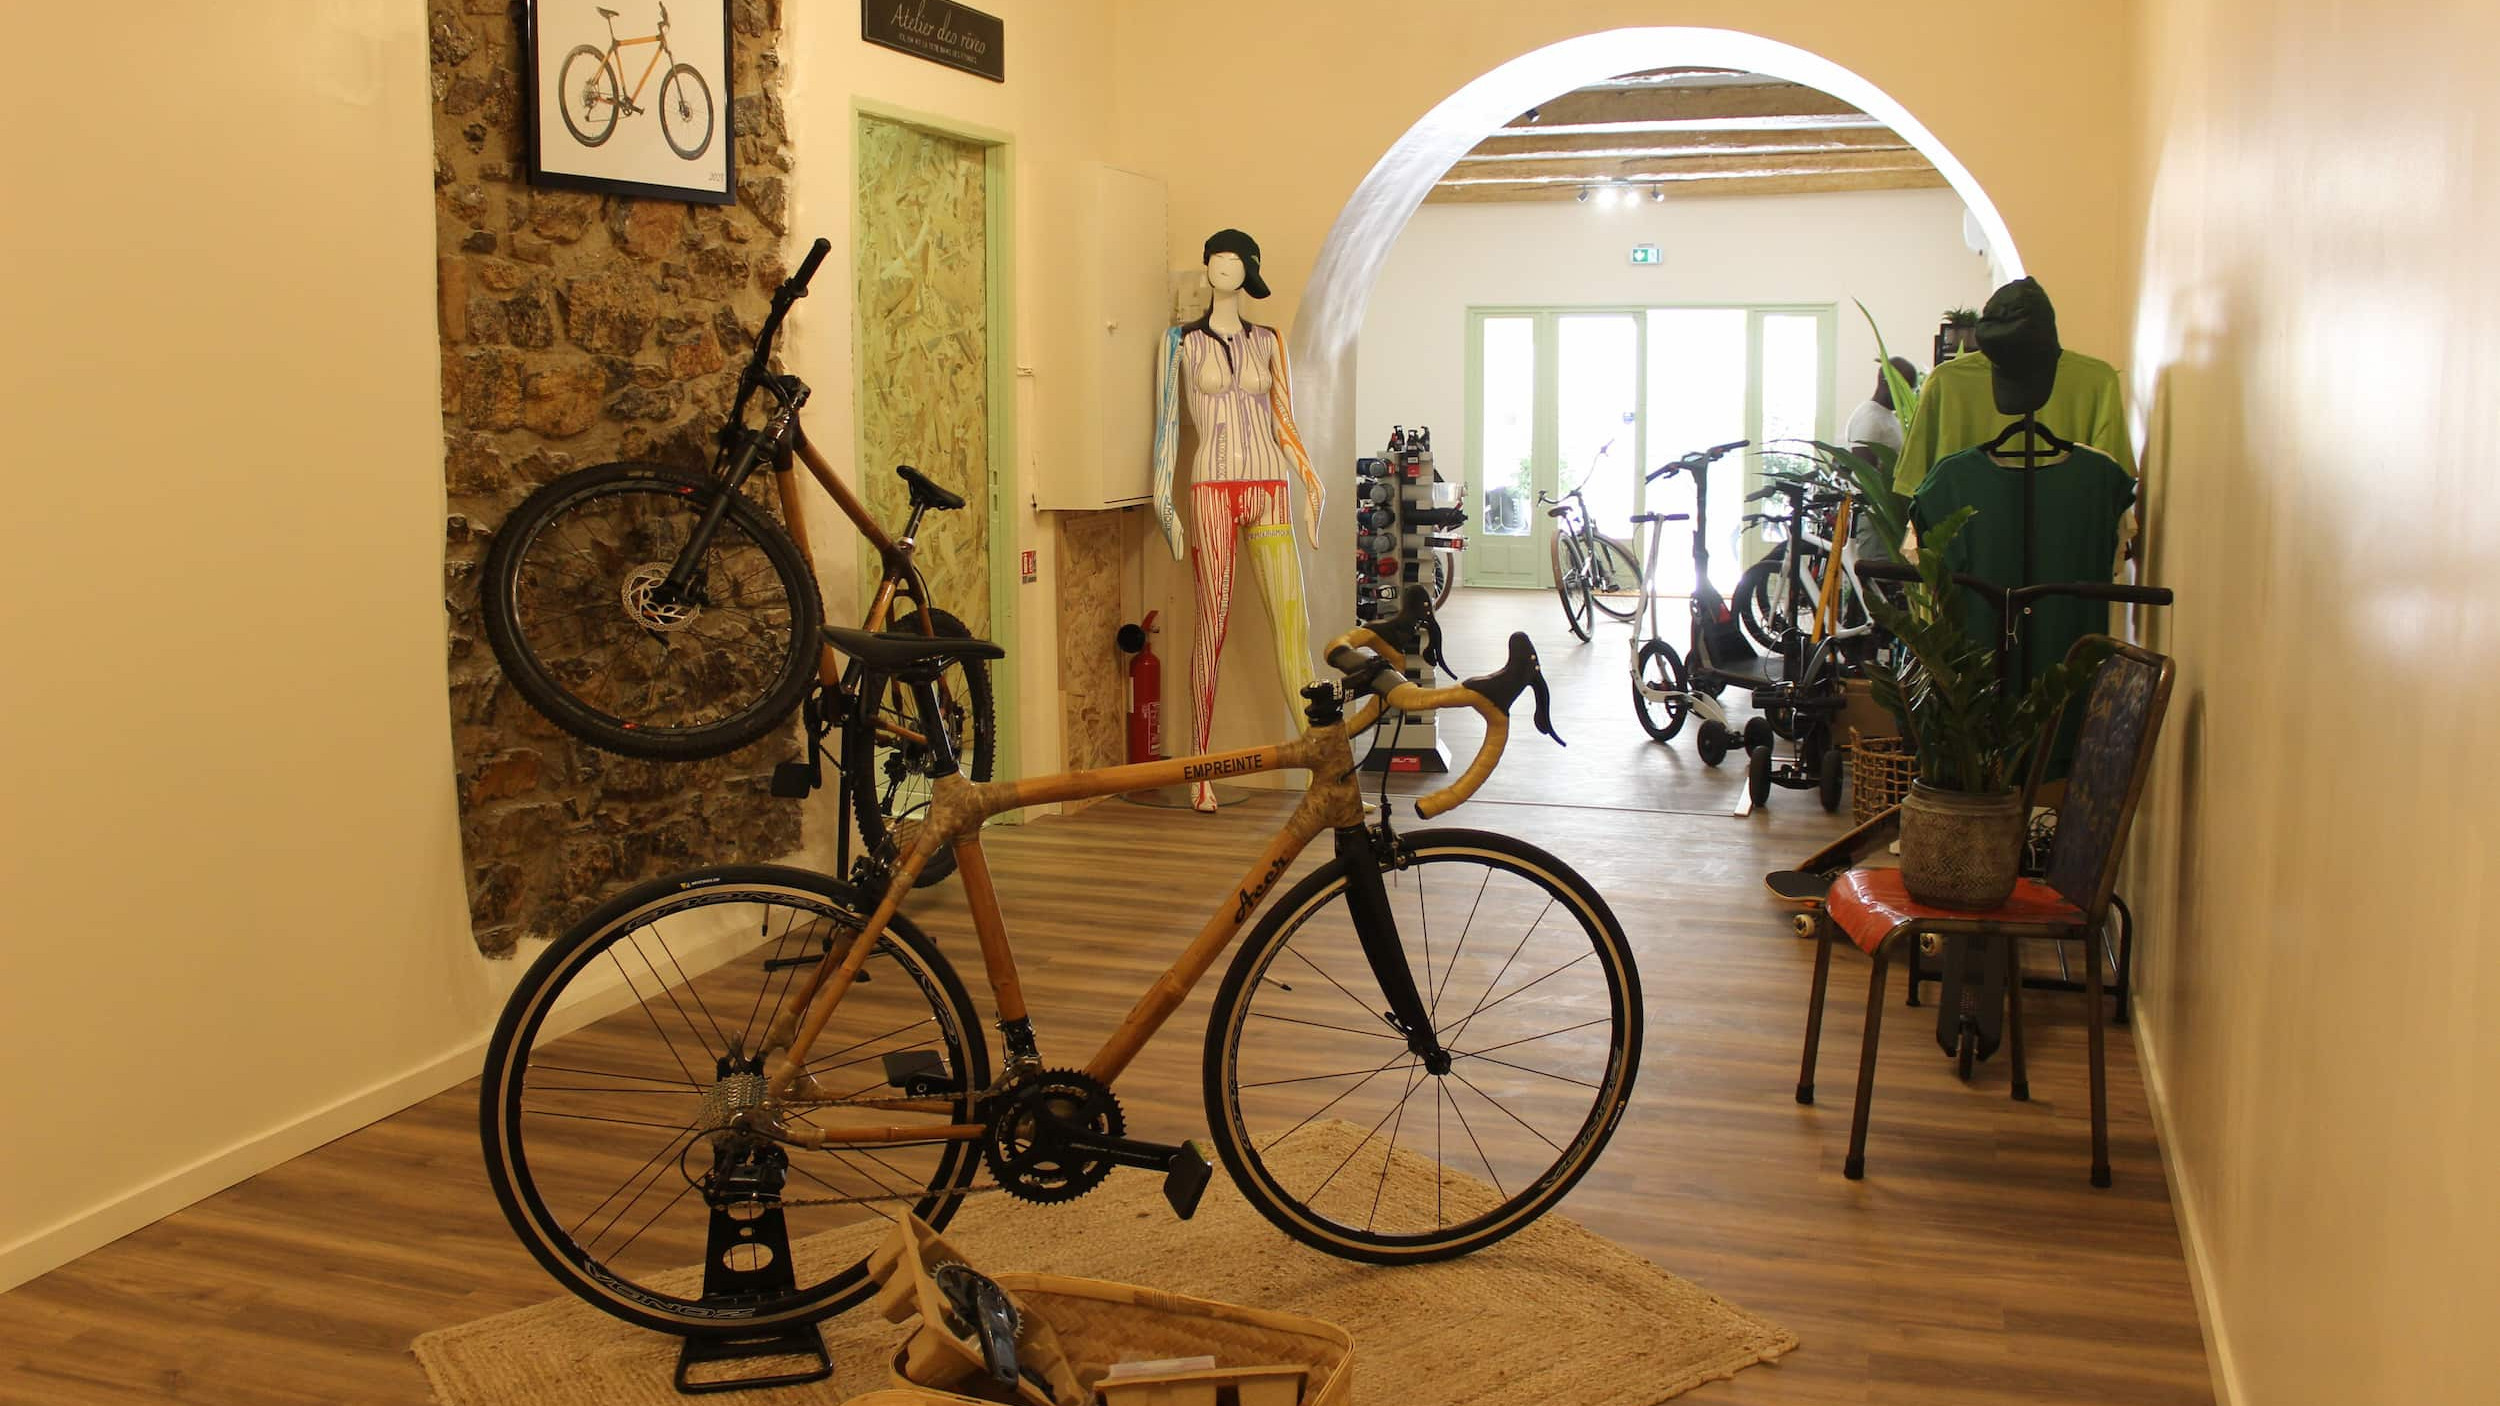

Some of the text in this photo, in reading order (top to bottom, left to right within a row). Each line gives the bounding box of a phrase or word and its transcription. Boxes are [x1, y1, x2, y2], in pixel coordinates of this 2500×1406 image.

[890, 0, 935, 37] Atelier
[937, 9, 957, 45] des
[1183, 754, 1263, 781] EMPREINTE
